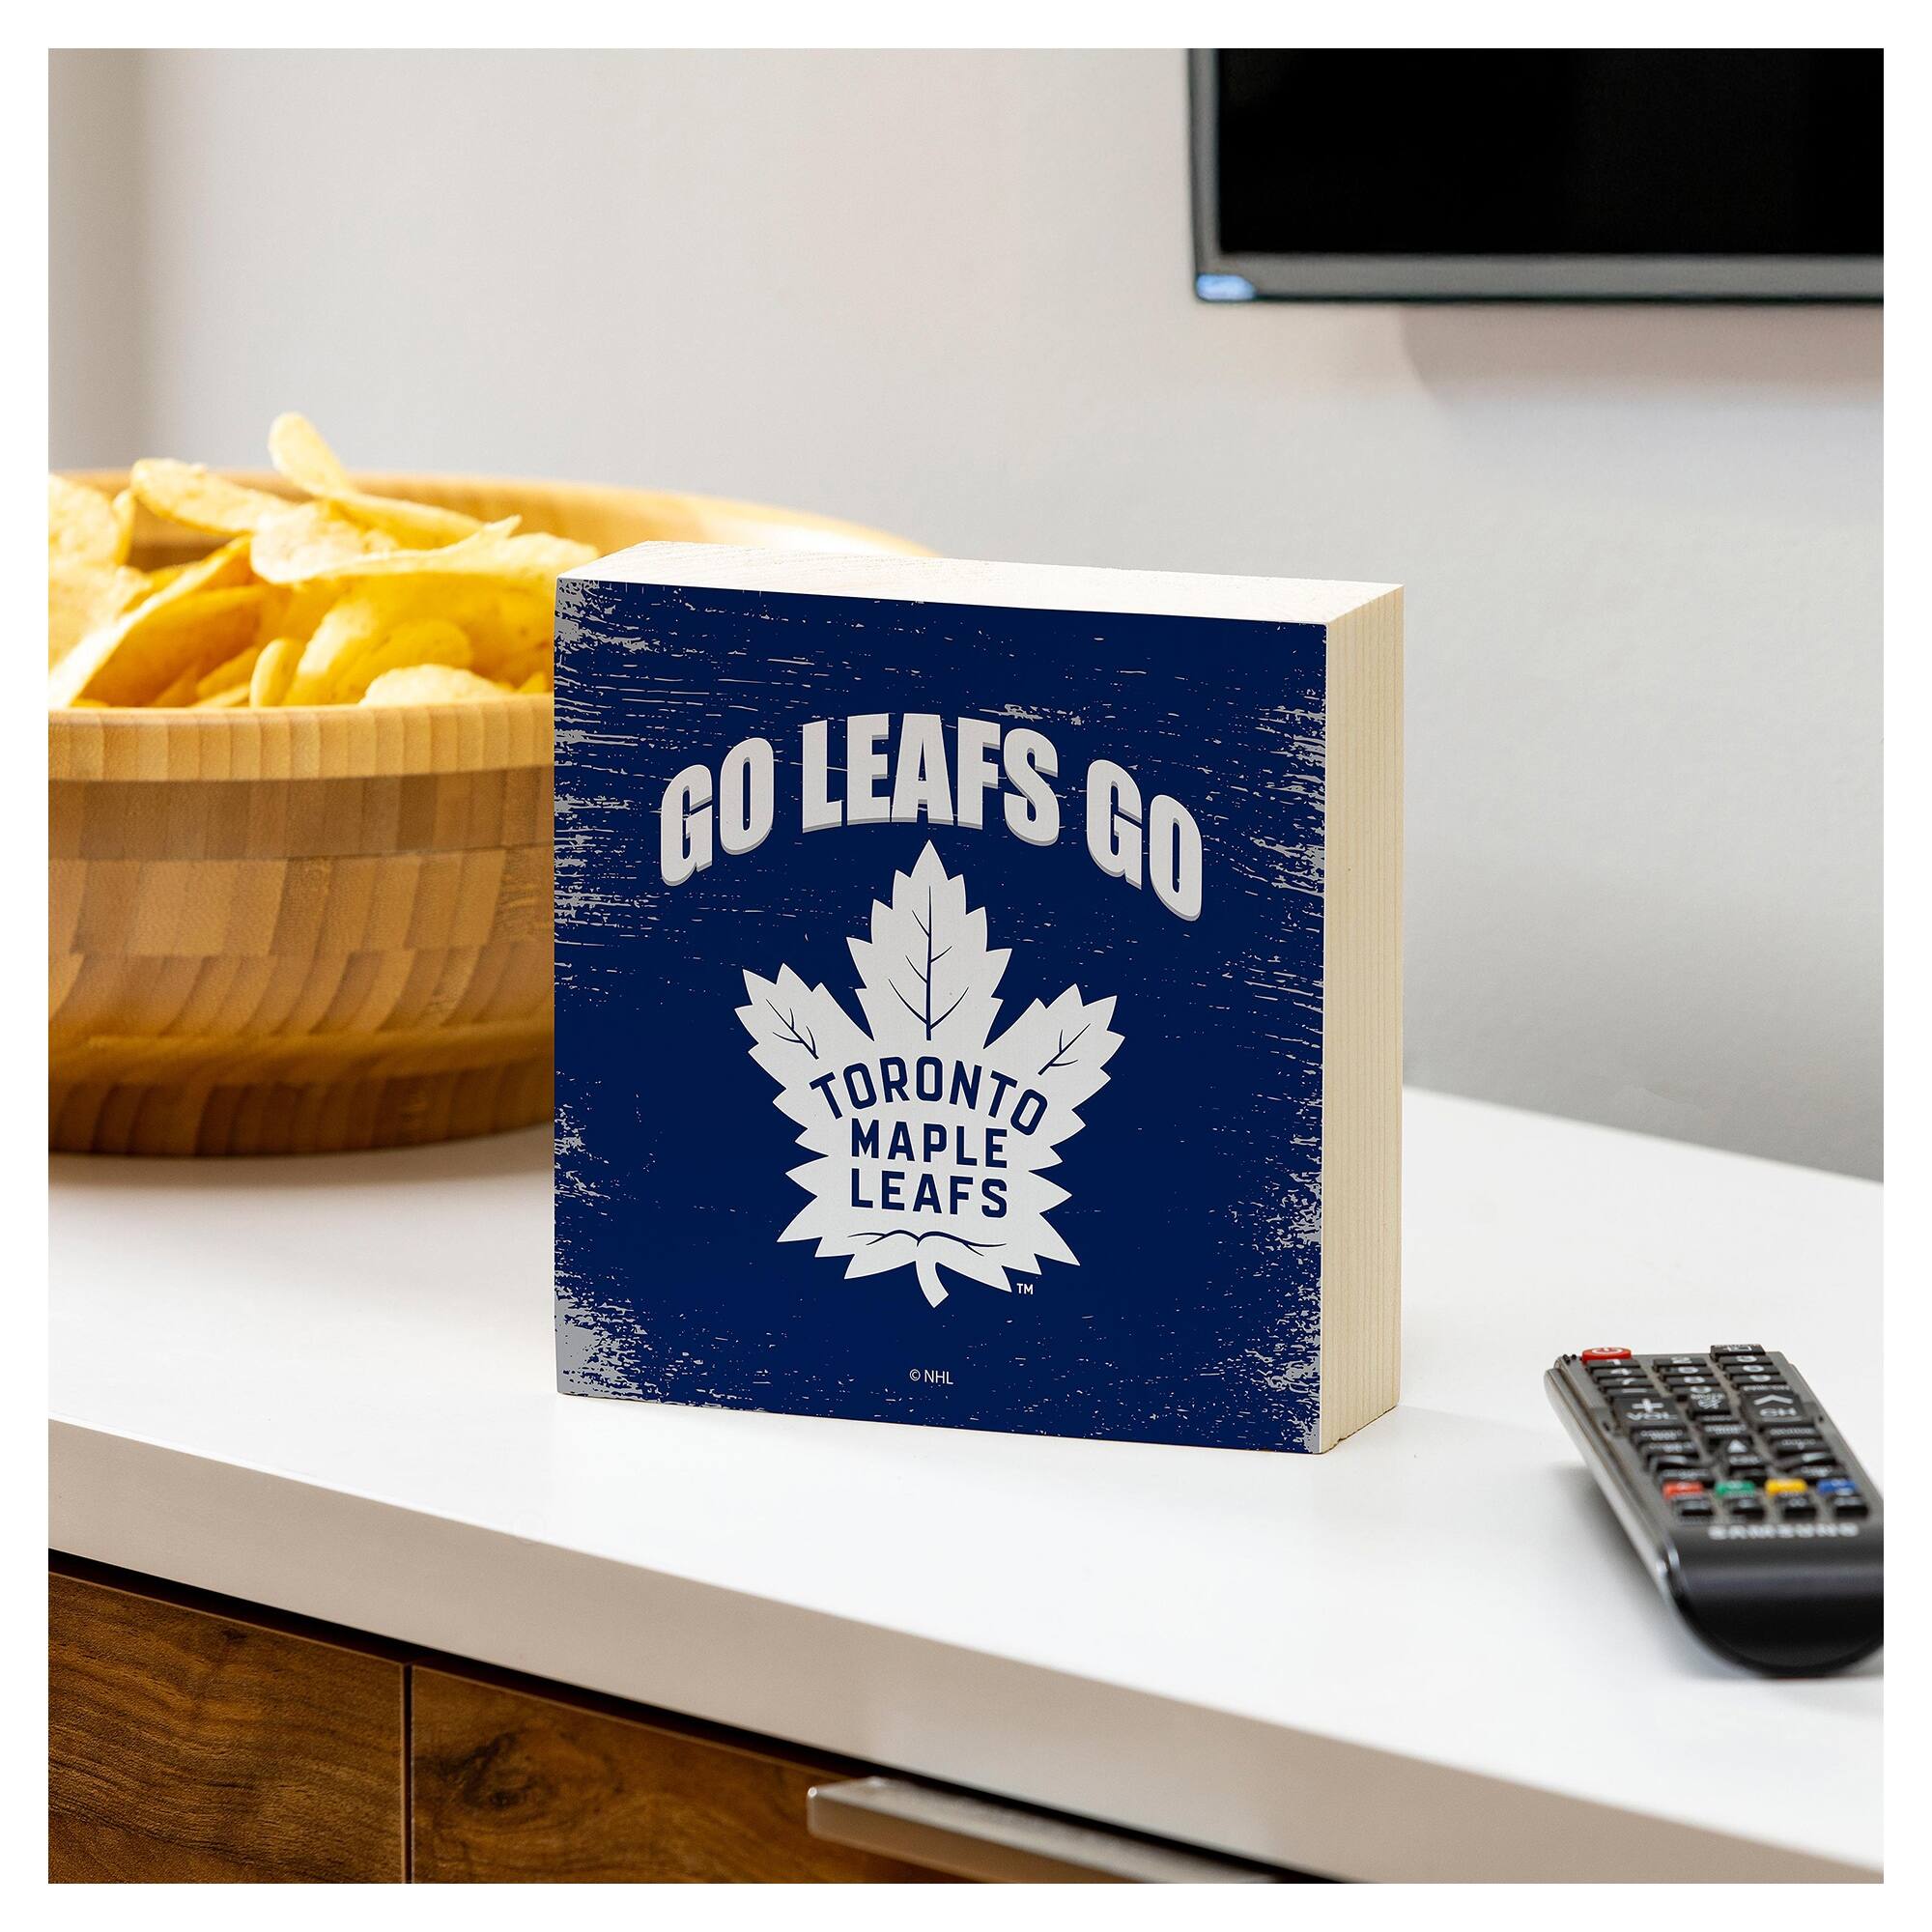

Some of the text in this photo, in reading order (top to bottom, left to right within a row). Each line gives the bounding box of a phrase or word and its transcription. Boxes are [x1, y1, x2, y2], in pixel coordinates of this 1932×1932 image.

[661, 713, 1203, 922] GO LEAFS GO
[809, 1056, 1048, 1136] TORONTO
[851, 1118, 1008, 1169] MAPLE
[851, 1168, 1008, 1218] LEAFS
[1016, 1283, 1034, 1295] TM
[923, 1370, 954, 1385] NHL
